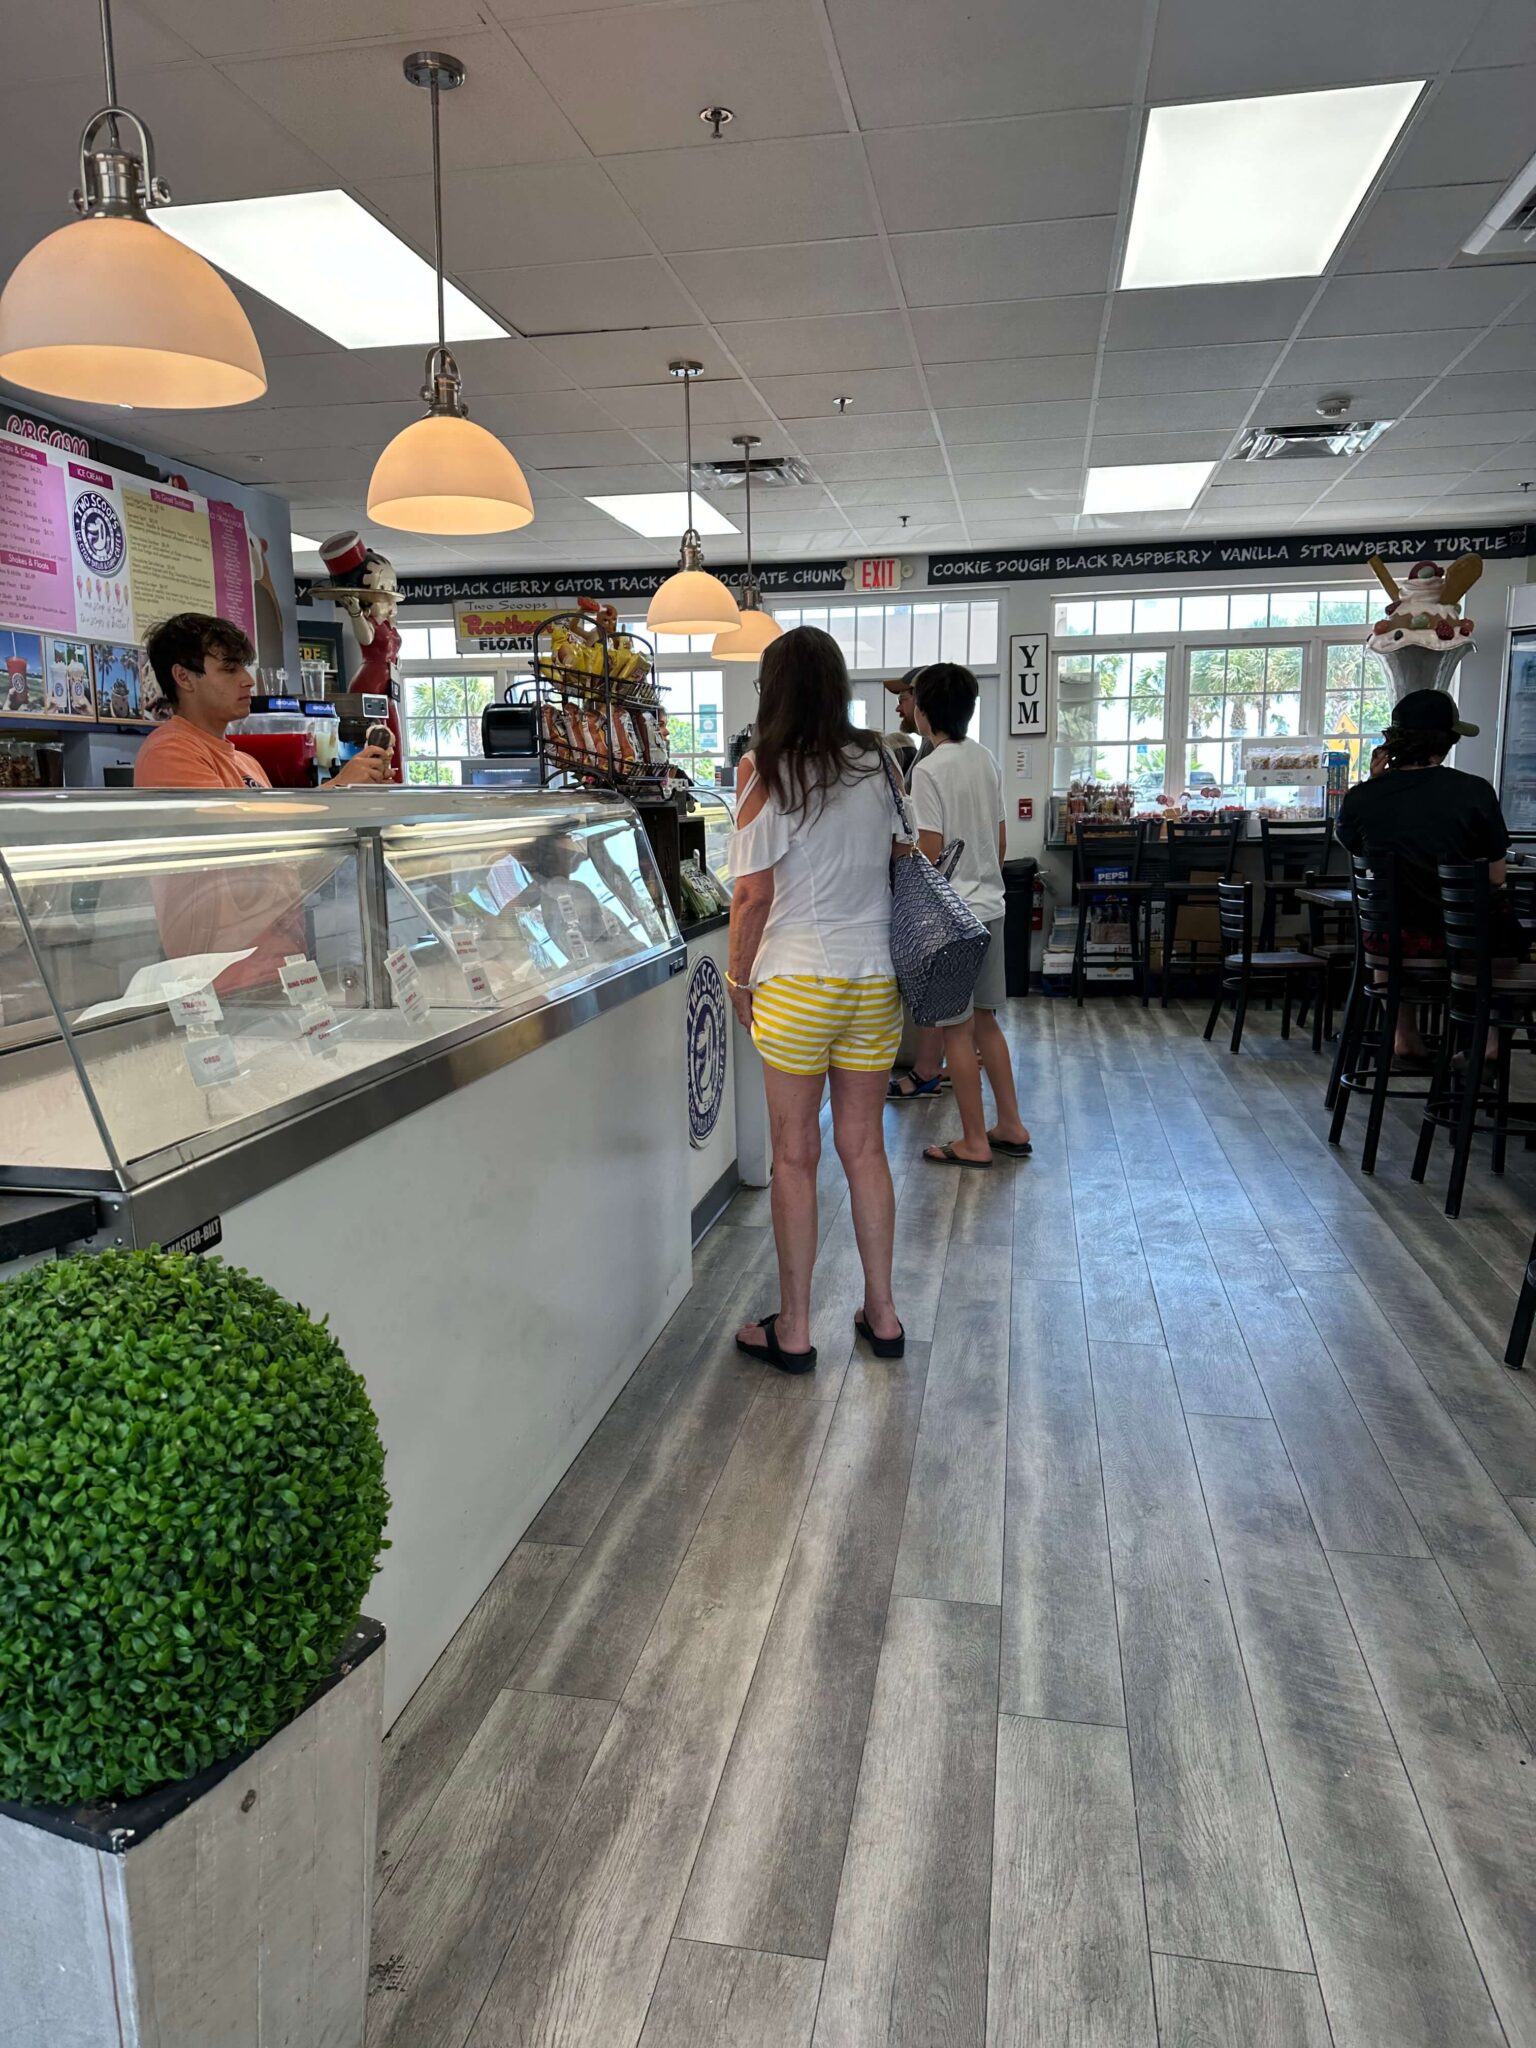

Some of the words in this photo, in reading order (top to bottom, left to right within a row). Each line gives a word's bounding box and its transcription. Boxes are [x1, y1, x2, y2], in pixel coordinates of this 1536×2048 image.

[76, 468, 86, 477] ICE
[87, 470, 105, 483] CREAM
[75, 496, 90, 516] TWO
[90, 494, 120, 530] SCOOPS
[996, 557, 1050, 573] DOUGH
[1056, 553, 1109, 571] BLACK
[1112, 549, 1212, 568] RASPBERRY
[1299, 539, 1426, 559] STRAWBERRY
[1433, 535, 1508, 553] TURTLE
[792, 568, 842, 583] CHUNK
[862, 560, 895, 588] EXIT
[397, 585, 443, 600] ALNUT
[492, 579, 550, 594] CHERRY
[554, 577, 603, 592] GATOR
[464, 601, 494, 611] Two
[498, 600, 548, 612] Scoops
[479, 637, 533, 651] FLOATS
[1018, 645, 1040, 724] YUM
[1097, 871, 1129, 881] PEPSI
[300, 976, 318, 986] CHERRY
[687, 972, 701, 1025] TWO
[701, 963, 725, 1029] SCOOPS
[167, 1219, 219, 1254] MASTER-BILT
